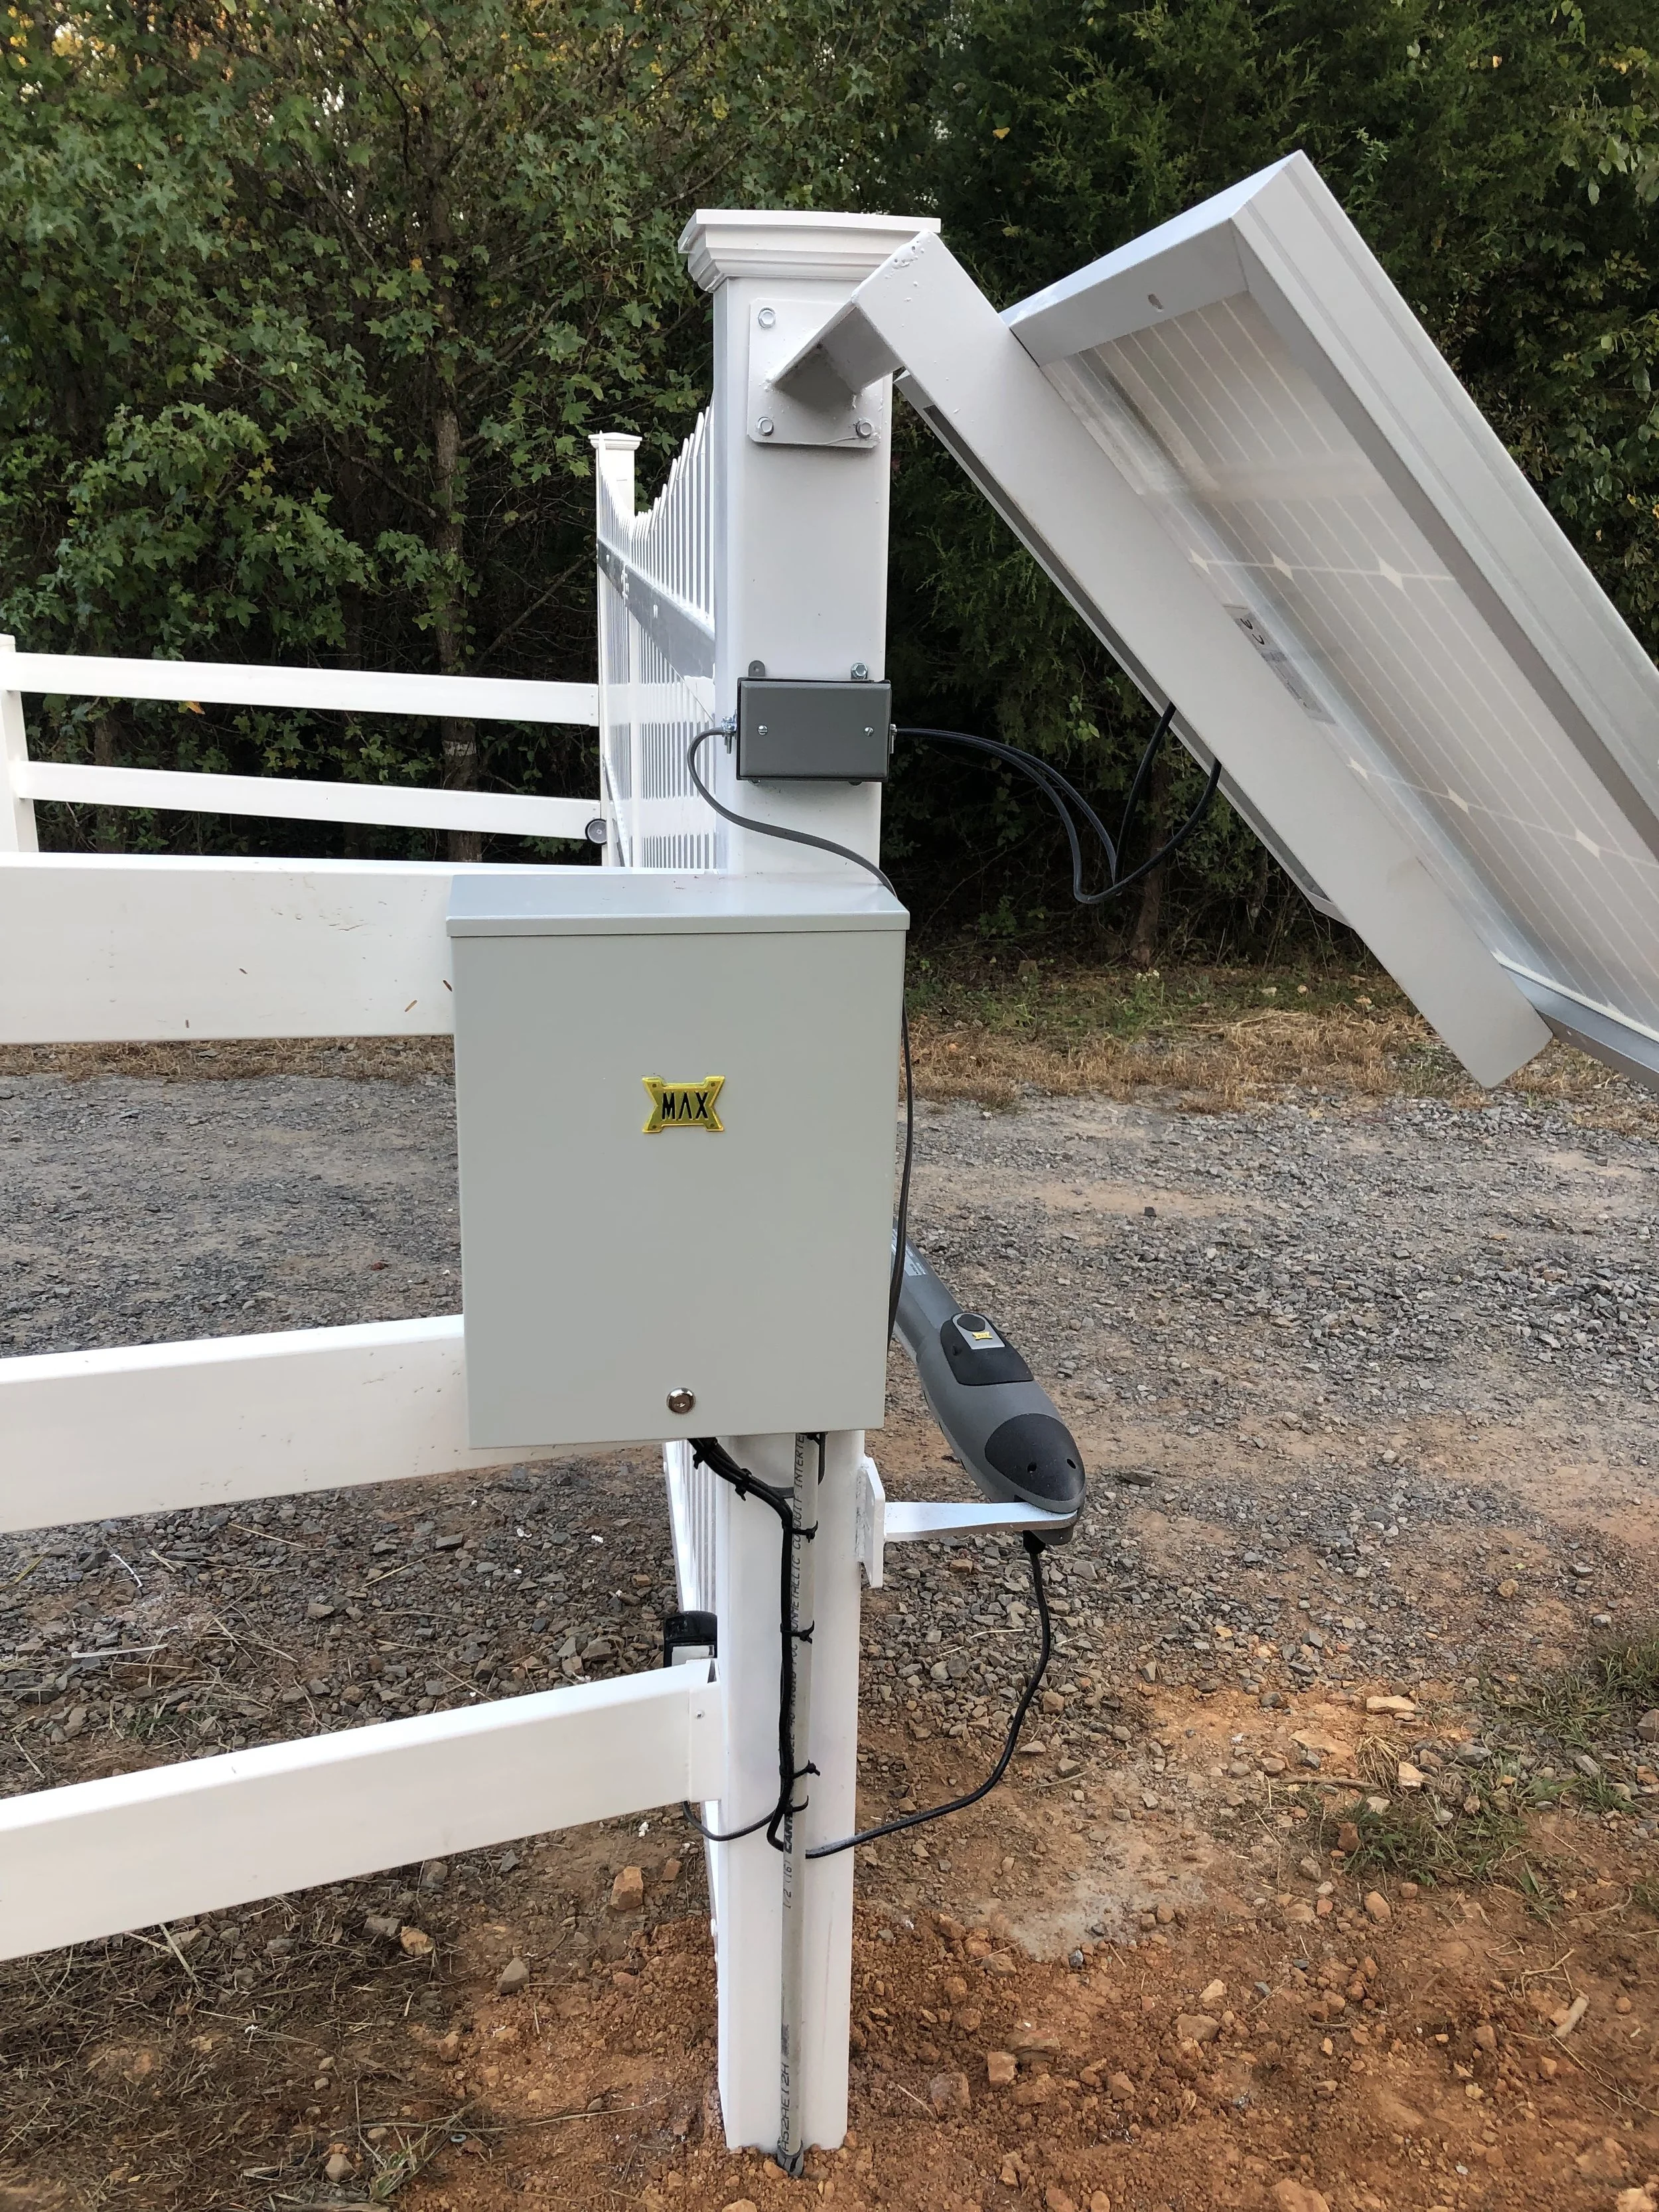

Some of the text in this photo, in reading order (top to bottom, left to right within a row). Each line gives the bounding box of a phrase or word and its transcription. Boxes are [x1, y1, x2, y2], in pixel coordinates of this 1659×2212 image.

[662, 1090, 709, 1120] MAX
[794, 1434, 804, 1489] INTERTE
[792, 1496, 802, 1550] CODUIT
[790, 1556, 800, 1632] ONMETALLIC
[783, 1860, 792, 1883] (16)
